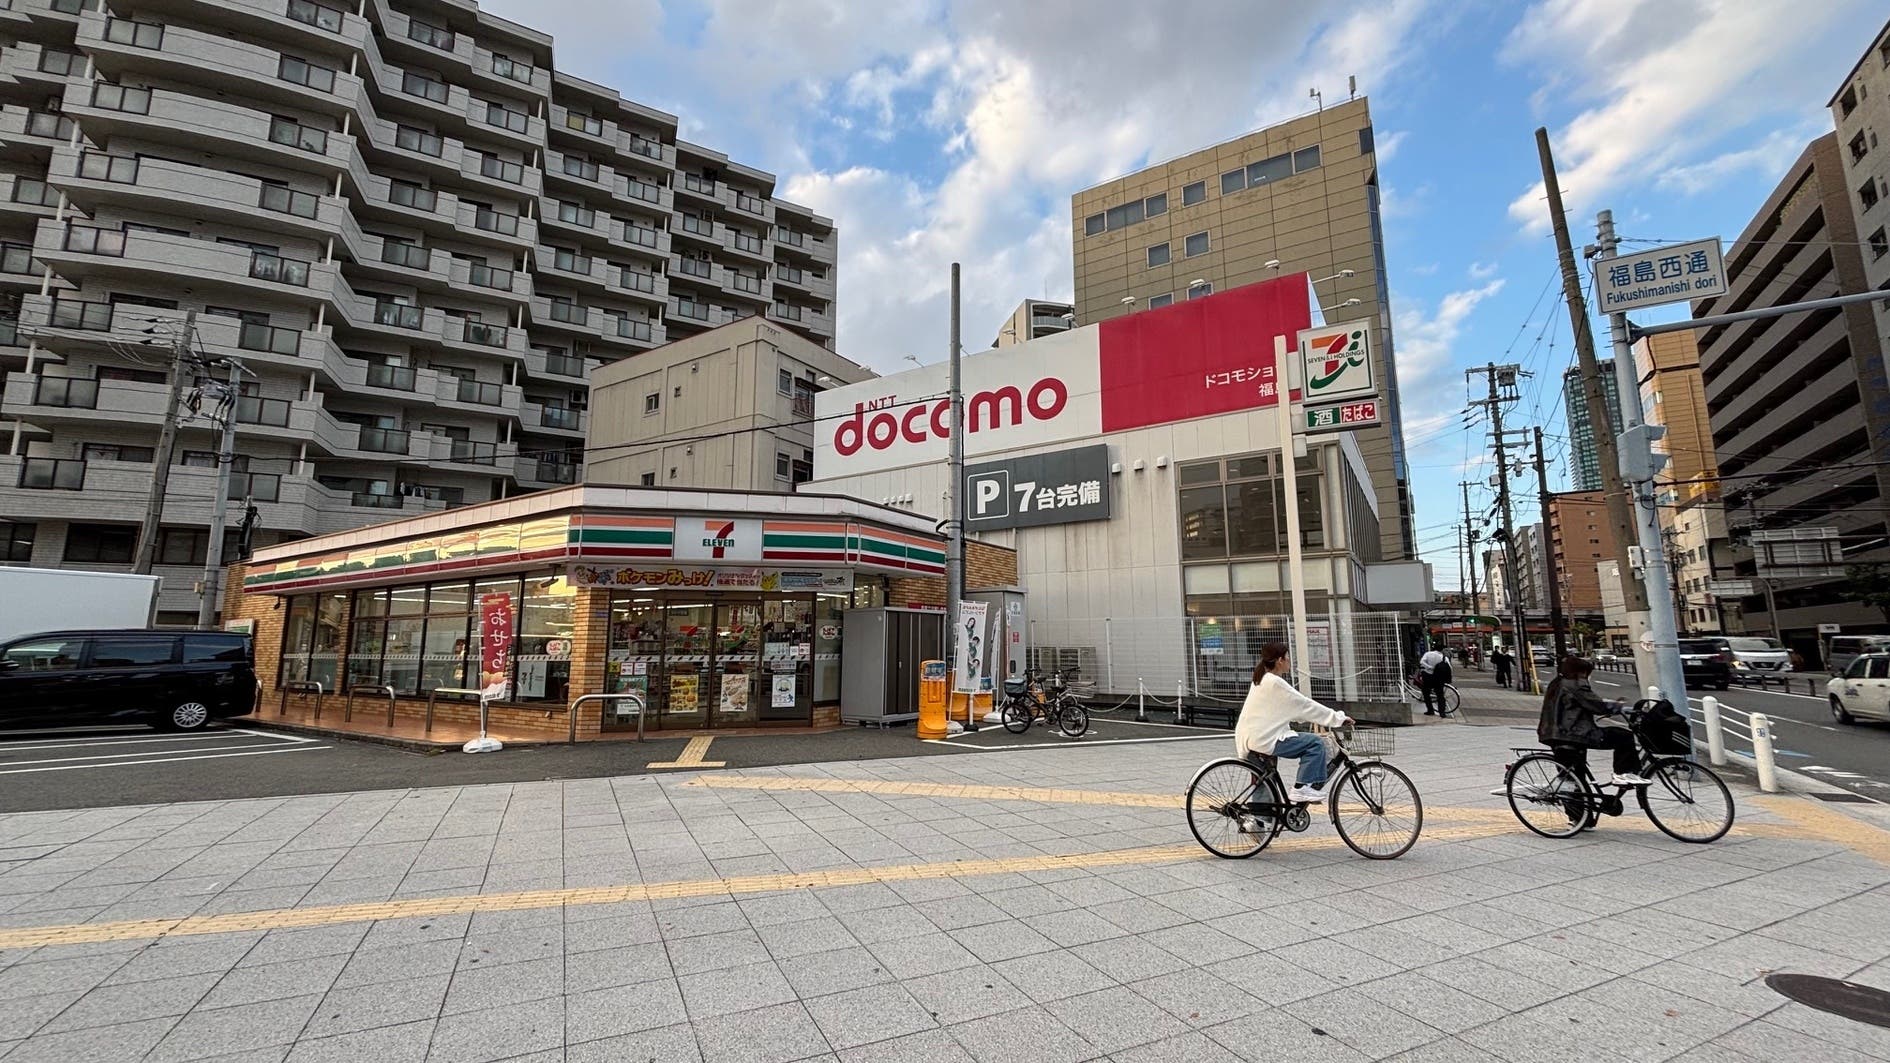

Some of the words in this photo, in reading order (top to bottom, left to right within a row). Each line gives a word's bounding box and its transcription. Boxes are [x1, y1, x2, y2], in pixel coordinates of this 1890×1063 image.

[1608, 250, 1710, 289] 福島西通
[1606, 281, 1691, 305] Fukushimanishi
[1694, 274, 1718, 290] dori
[1307, 356, 1326, 364] SEVEN
[1334, 349, 1365, 360] HOLDINGS
[1205, 366, 1278, 389] ドコモショ
[1258, 382, 1279, 397] 福
[868, 395, 897, 412] NTT
[1314, 408, 1333, 426] 酒
[1342, 404, 1375, 422] たばこ
[834, 377, 1068, 457] docomo
[976, 479, 1000, 515] P
[1013, 480, 1101, 513] 7台完備
